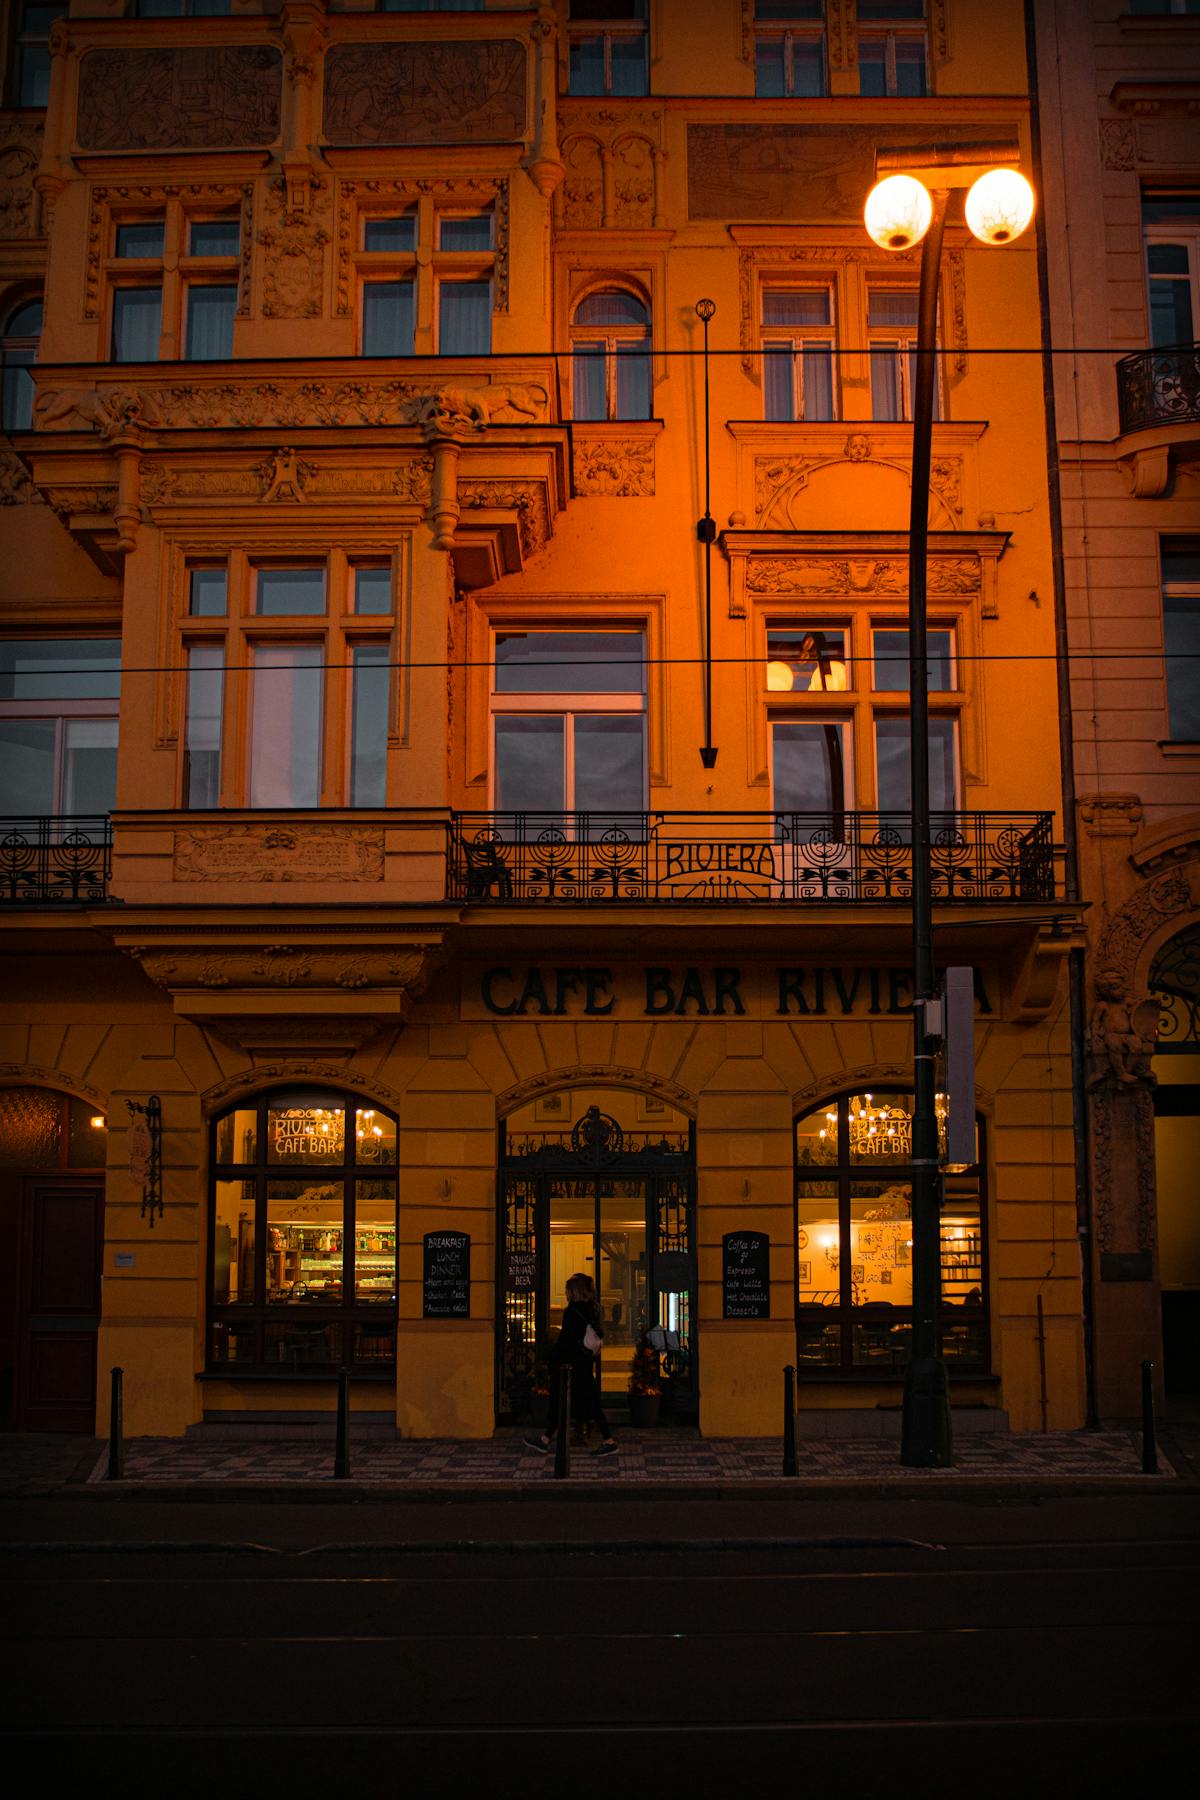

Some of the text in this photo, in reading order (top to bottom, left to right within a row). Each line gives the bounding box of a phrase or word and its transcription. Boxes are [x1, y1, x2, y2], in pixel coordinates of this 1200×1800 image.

[667, 844, 775, 879] RIVIERA
[480, 967, 616, 1015] CAFE
[643, 967, 745, 1015] BAR
[275, 1138, 336, 1153] CAFE BAR
[892, 1138, 912, 1154] BA
[427, 1238, 467, 1249] BREAKFAST
[727, 1239, 760, 1253] Coffee to
[510, 1255, 536, 1265] DRAUGHT
[508, 1265, 536, 1275] BERNARD
[727, 1266, 756, 1277] Espresso
[515, 1276, 531, 1286] BEER
[726, 1305, 759, 1316] Desserts
